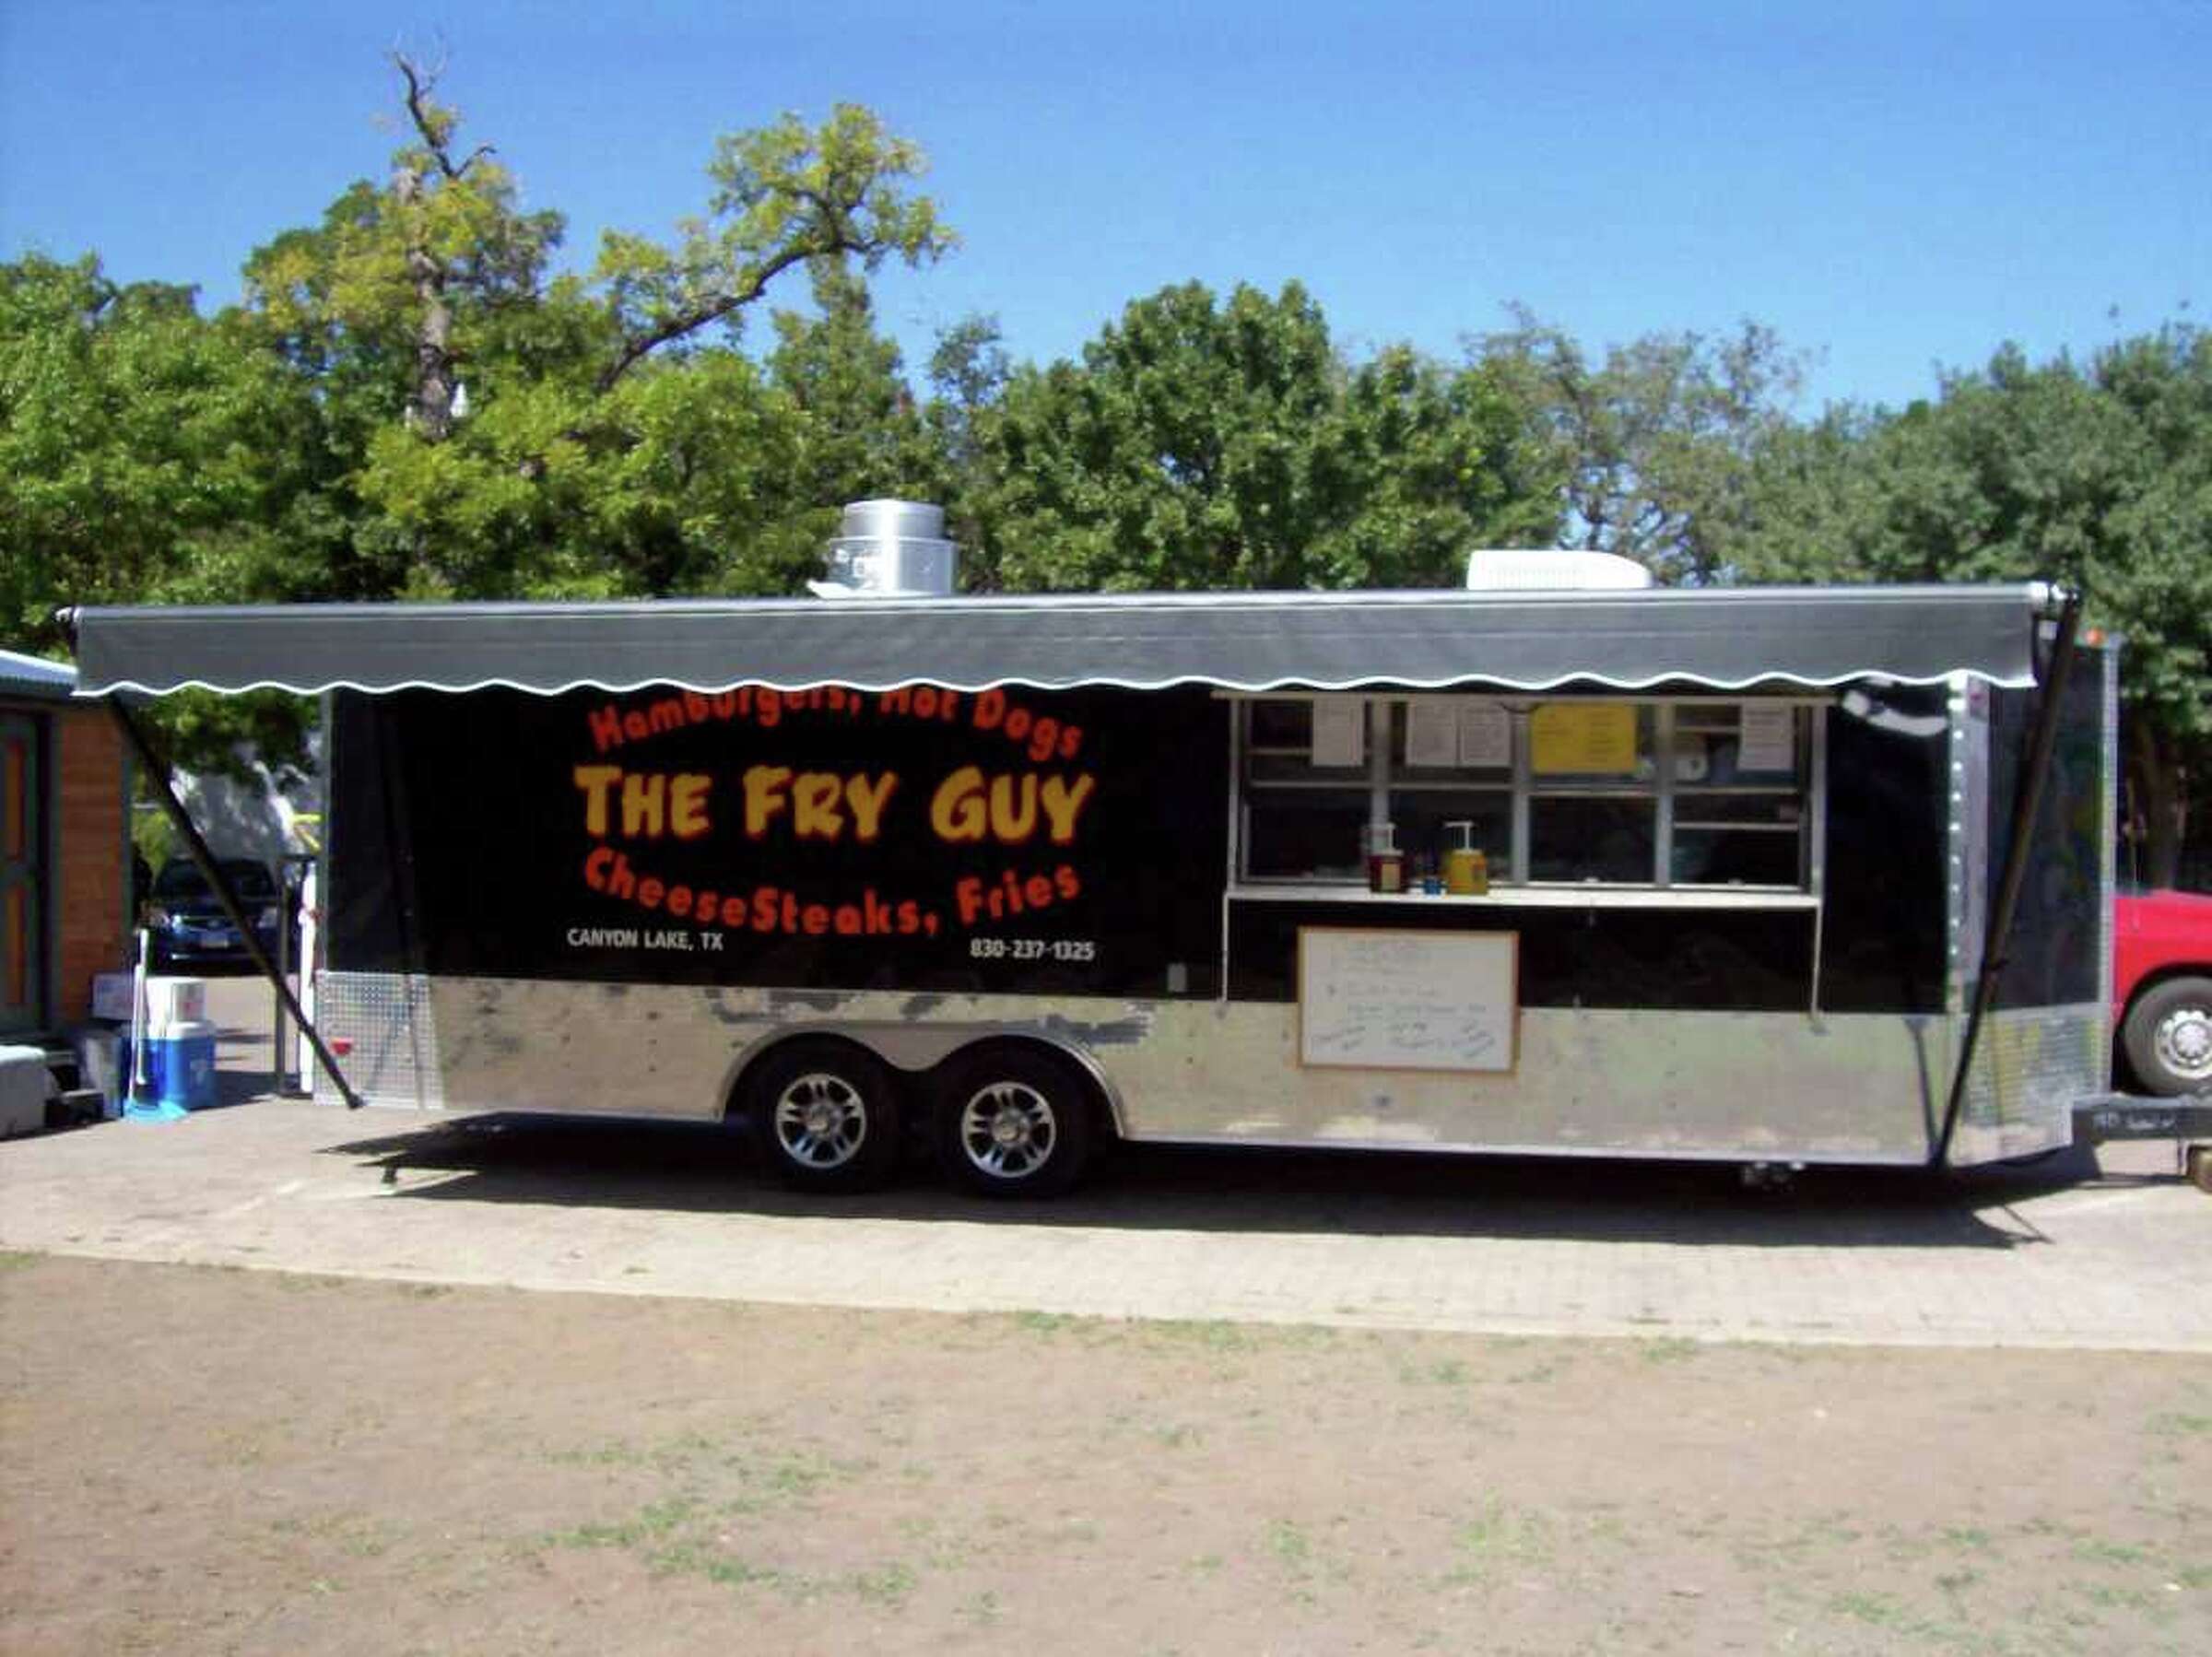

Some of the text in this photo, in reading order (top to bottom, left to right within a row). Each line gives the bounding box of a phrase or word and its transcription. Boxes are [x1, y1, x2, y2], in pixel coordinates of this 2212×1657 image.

[972, 687, 1081, 762] Dogs
[573, 764, 1095, 844] THE FRY GUY
[584, 846, 1080, 936] CheeseSteaks, Fries
[567, 928, 724, 951] CANYON LAKE, TX
